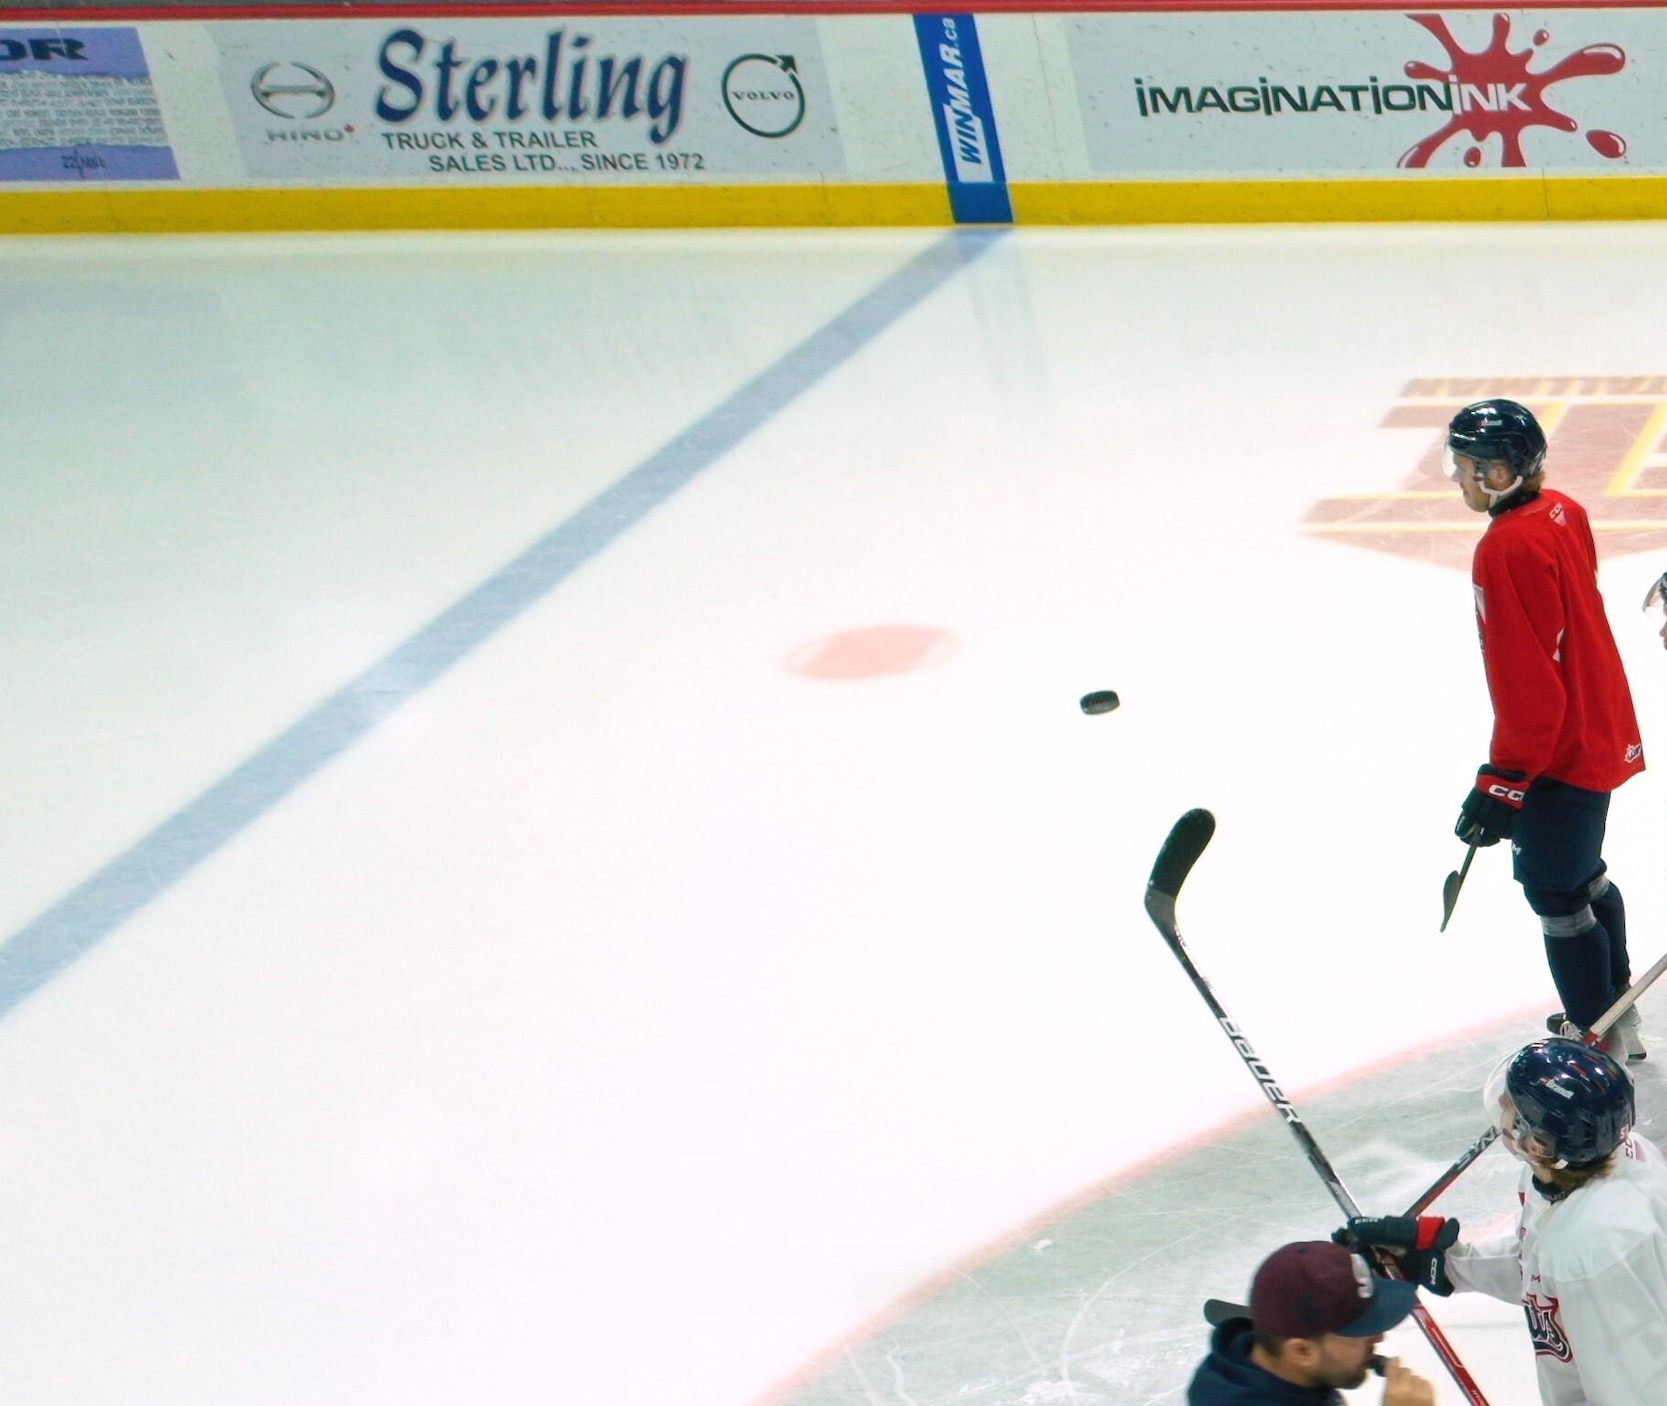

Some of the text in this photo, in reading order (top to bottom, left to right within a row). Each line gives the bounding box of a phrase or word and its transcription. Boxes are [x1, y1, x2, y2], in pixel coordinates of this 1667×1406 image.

[376, 29, 689, 145] Sterling
[731, 90, 796, 102] VOLVO
[267, 129, 344, 142] HINO
[381, 131, 599, 150] TRUCK & TRAILER
[430, 155, 507, 172] SALES
[581, 153, 649, 171] SINCE
[656, 153, 705, 171] 1972
